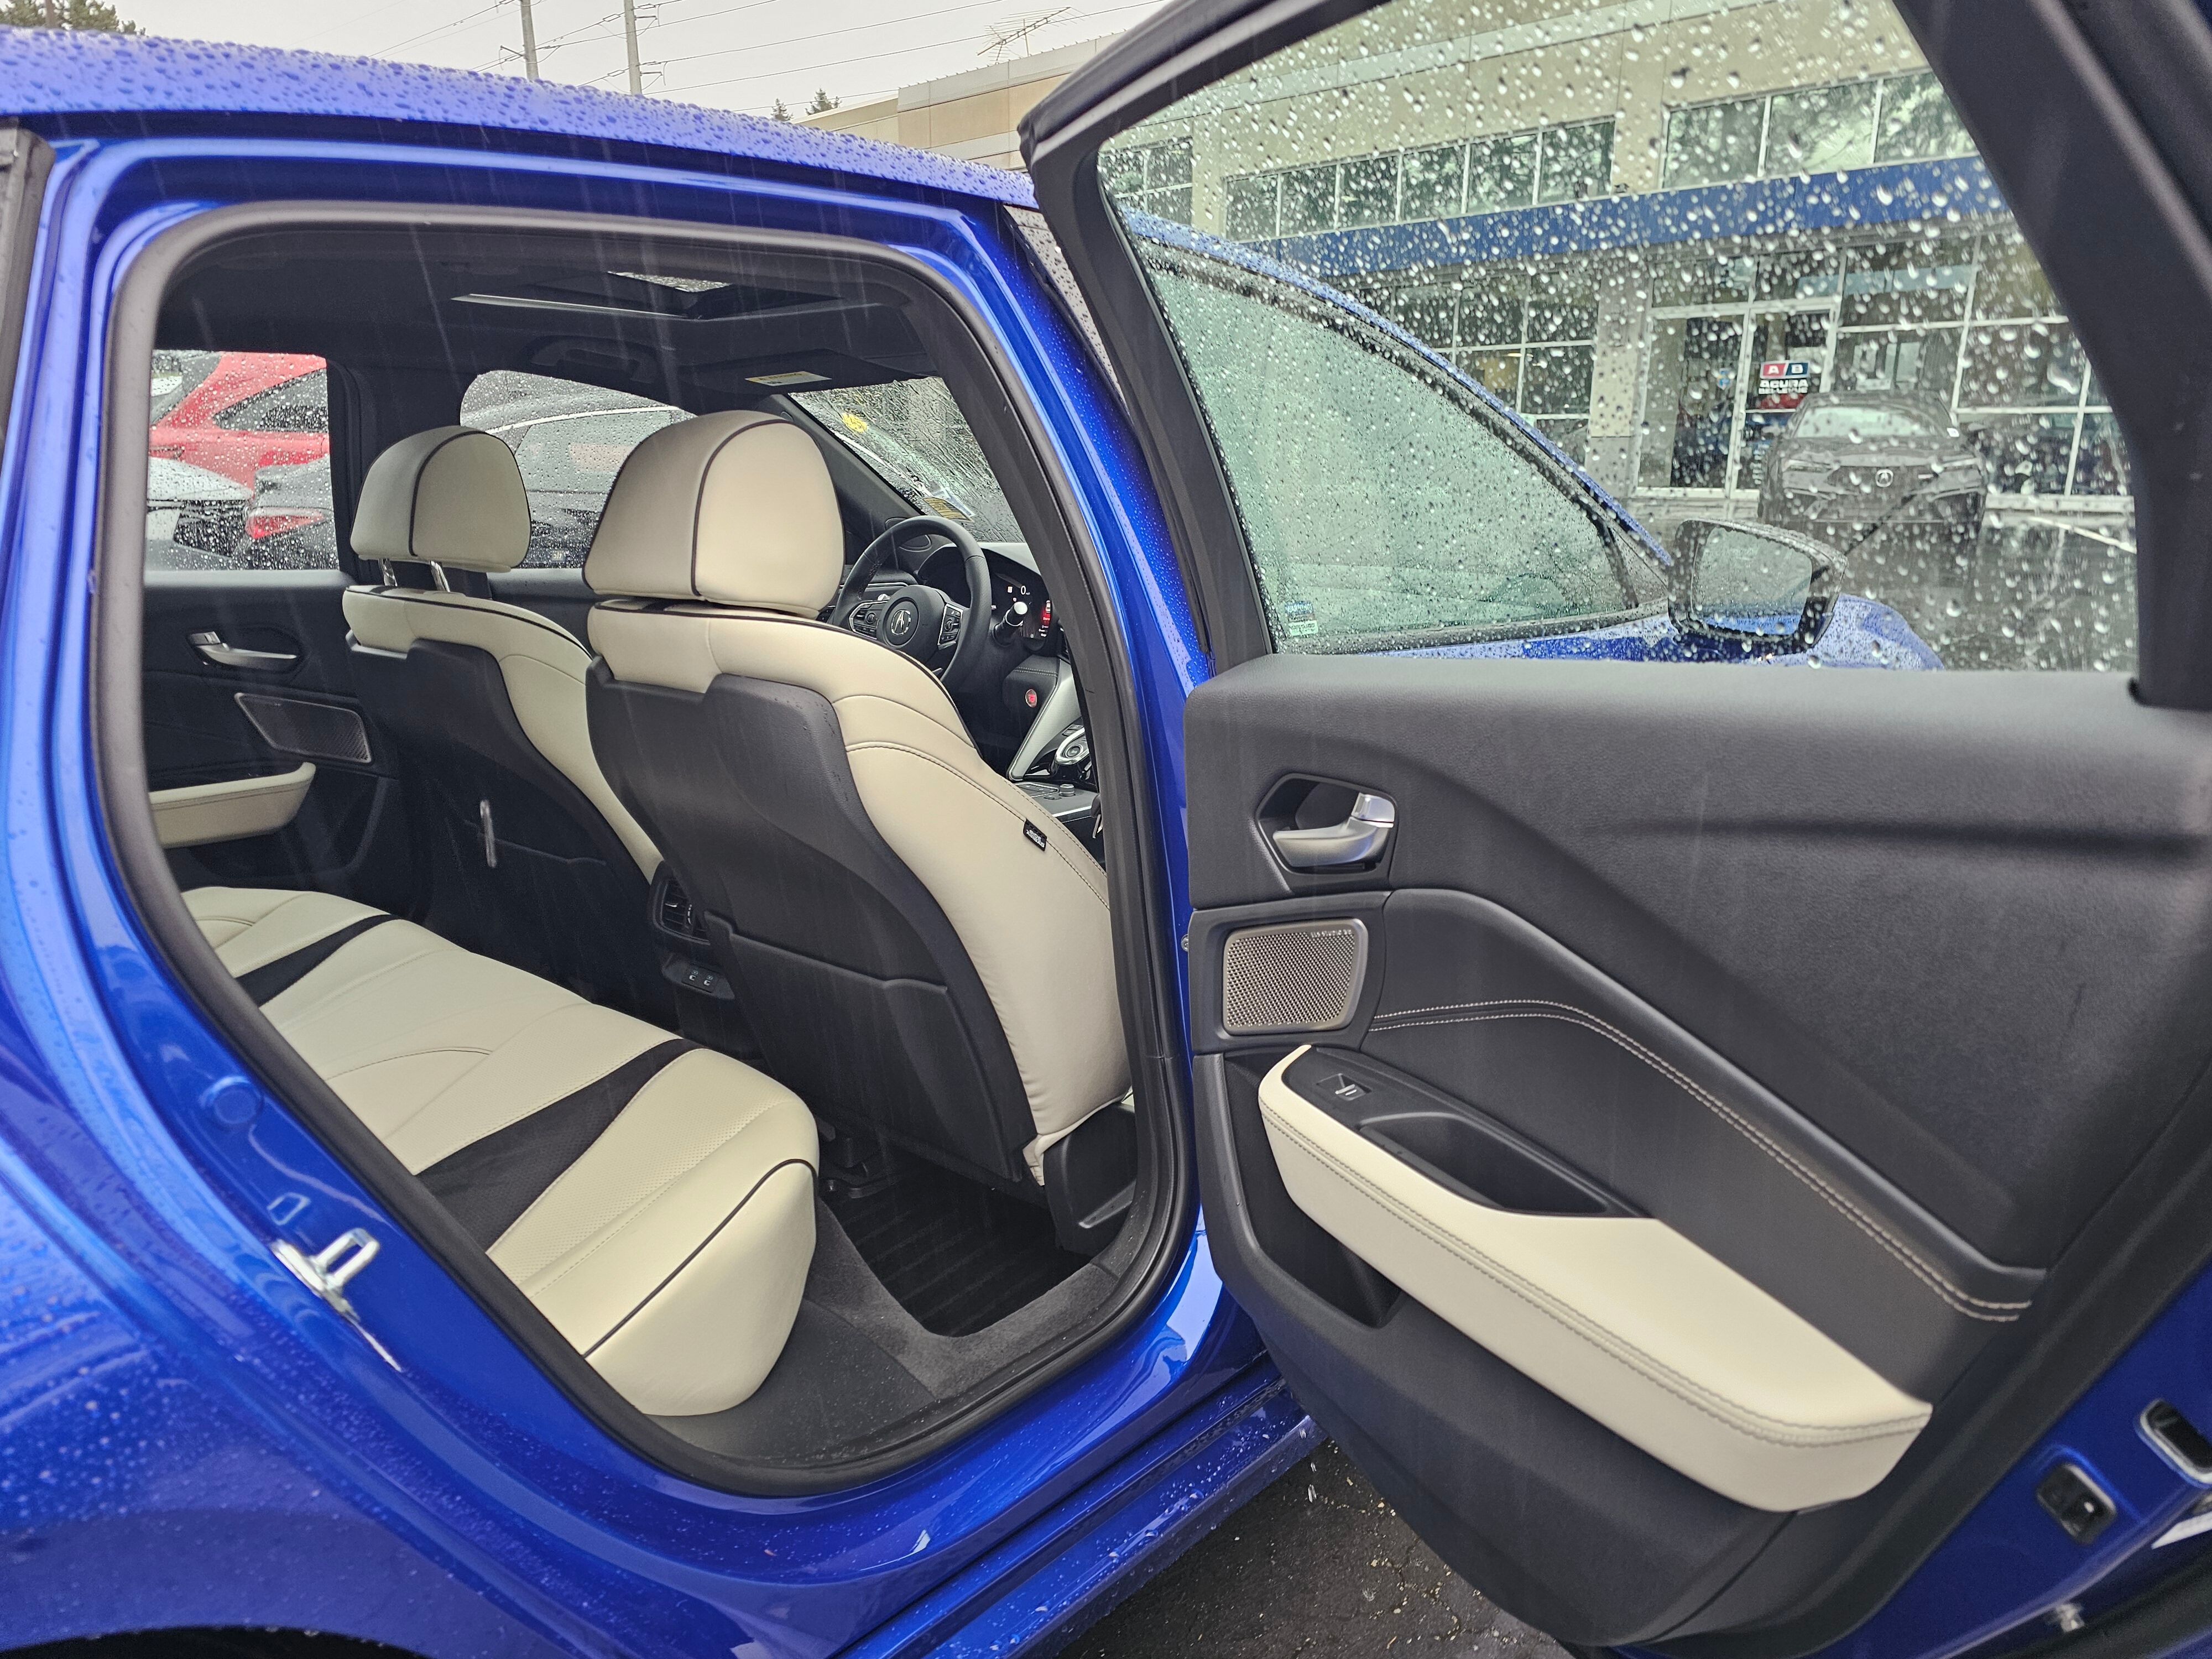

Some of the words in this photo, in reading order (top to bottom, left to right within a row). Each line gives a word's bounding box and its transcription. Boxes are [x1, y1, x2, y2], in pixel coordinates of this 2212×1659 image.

[1768, 366, 1779, 374] A
[1791, 364, 1803, 373] B
[1760, 379, 1808, 388] ACURA
[1021, 585, 1026, 594] 0
